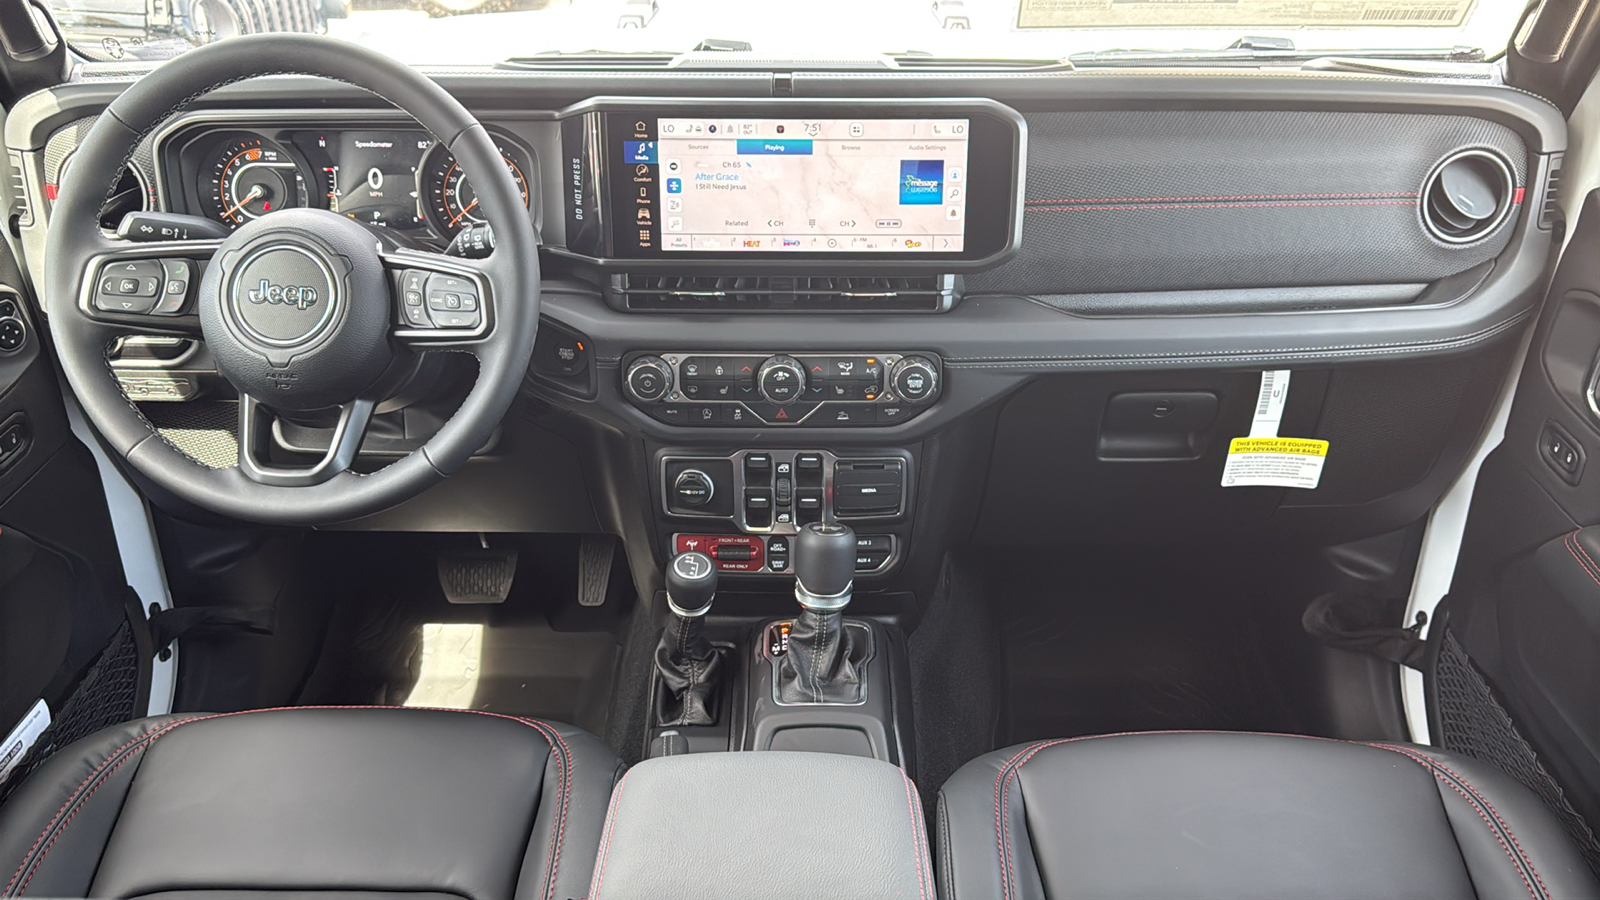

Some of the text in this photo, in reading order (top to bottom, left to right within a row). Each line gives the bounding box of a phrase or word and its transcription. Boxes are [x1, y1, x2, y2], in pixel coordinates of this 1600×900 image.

[663, 124, 674, 132] LO
[804, 124, 821, 132] 7:51
[952, 125, 964, 133] LO
[573, 158, 581, 185] PRESS
[368, 168, 383, 189] 0
[374, 211, 380, 219] P
[576, 208, 583, 220] DO
[248, 278, 318, 310] Jeep
